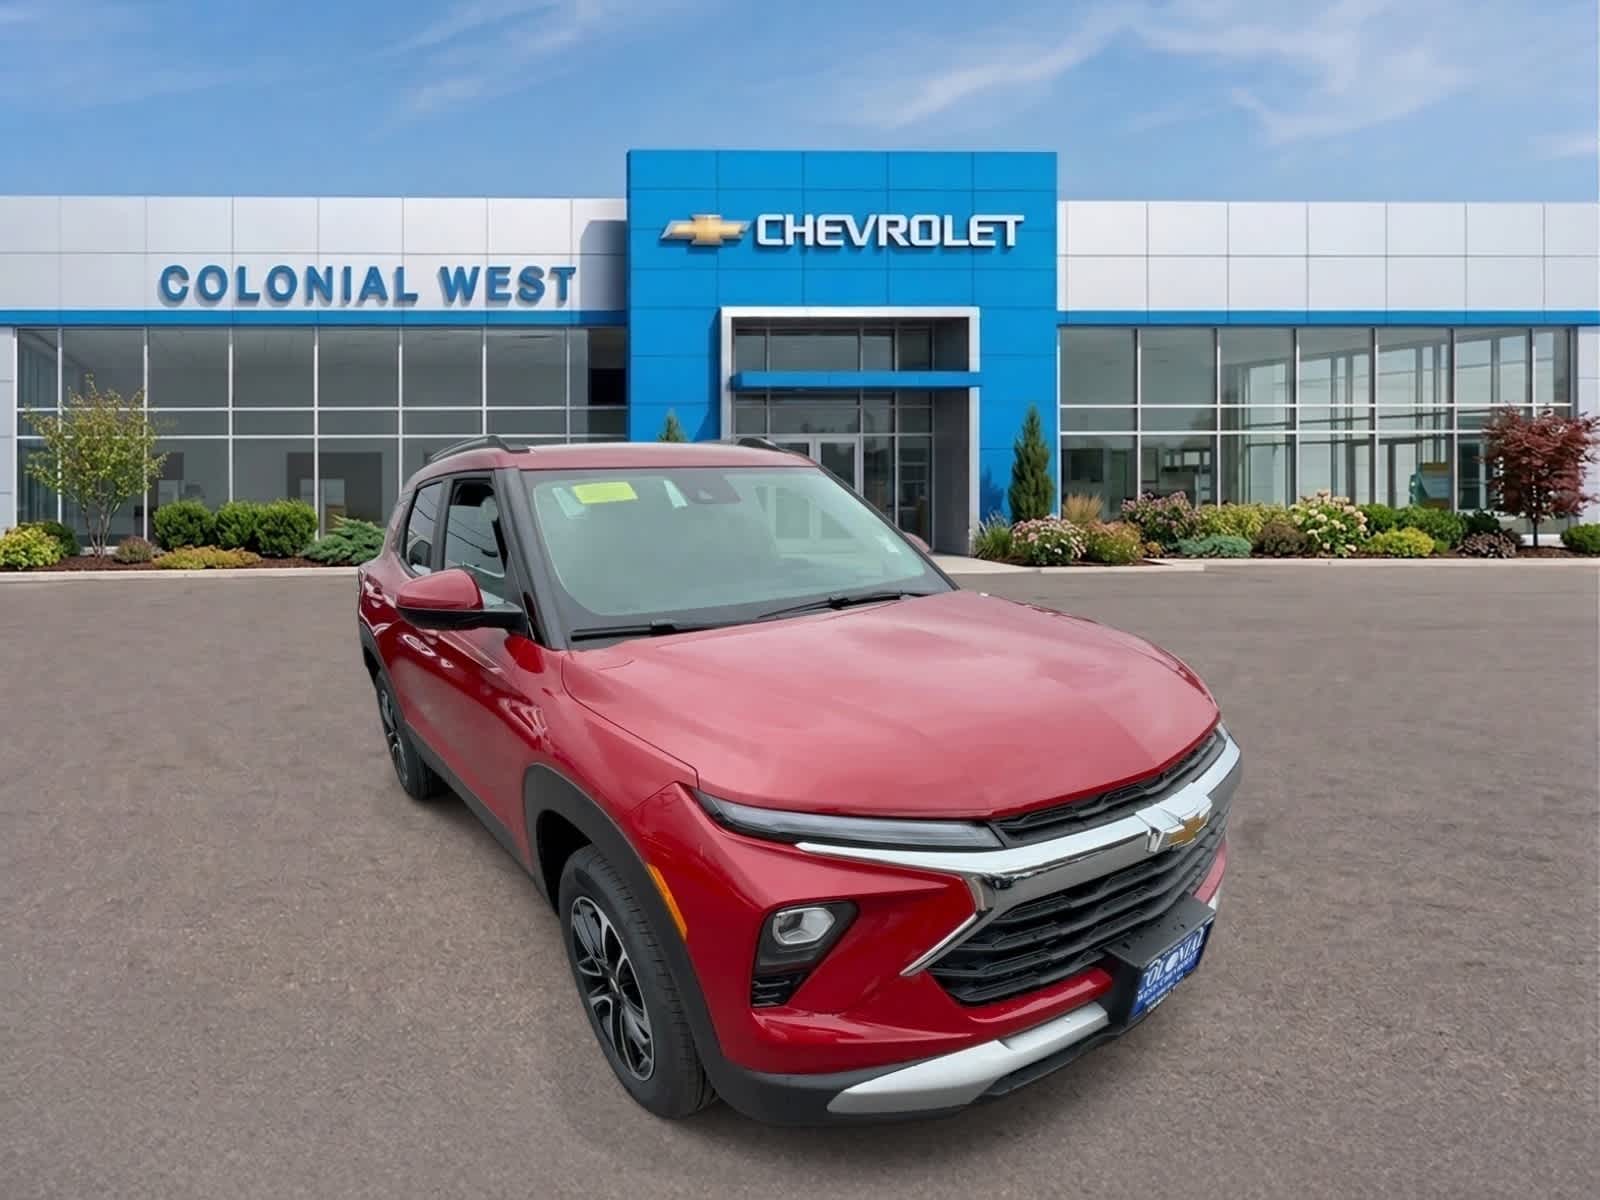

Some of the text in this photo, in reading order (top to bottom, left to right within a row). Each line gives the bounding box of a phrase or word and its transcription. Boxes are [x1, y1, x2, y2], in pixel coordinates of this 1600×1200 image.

[757, 213, 1025, 248] CHEVROLET
[160, 264, 577, 305] COLONIAL WEST
